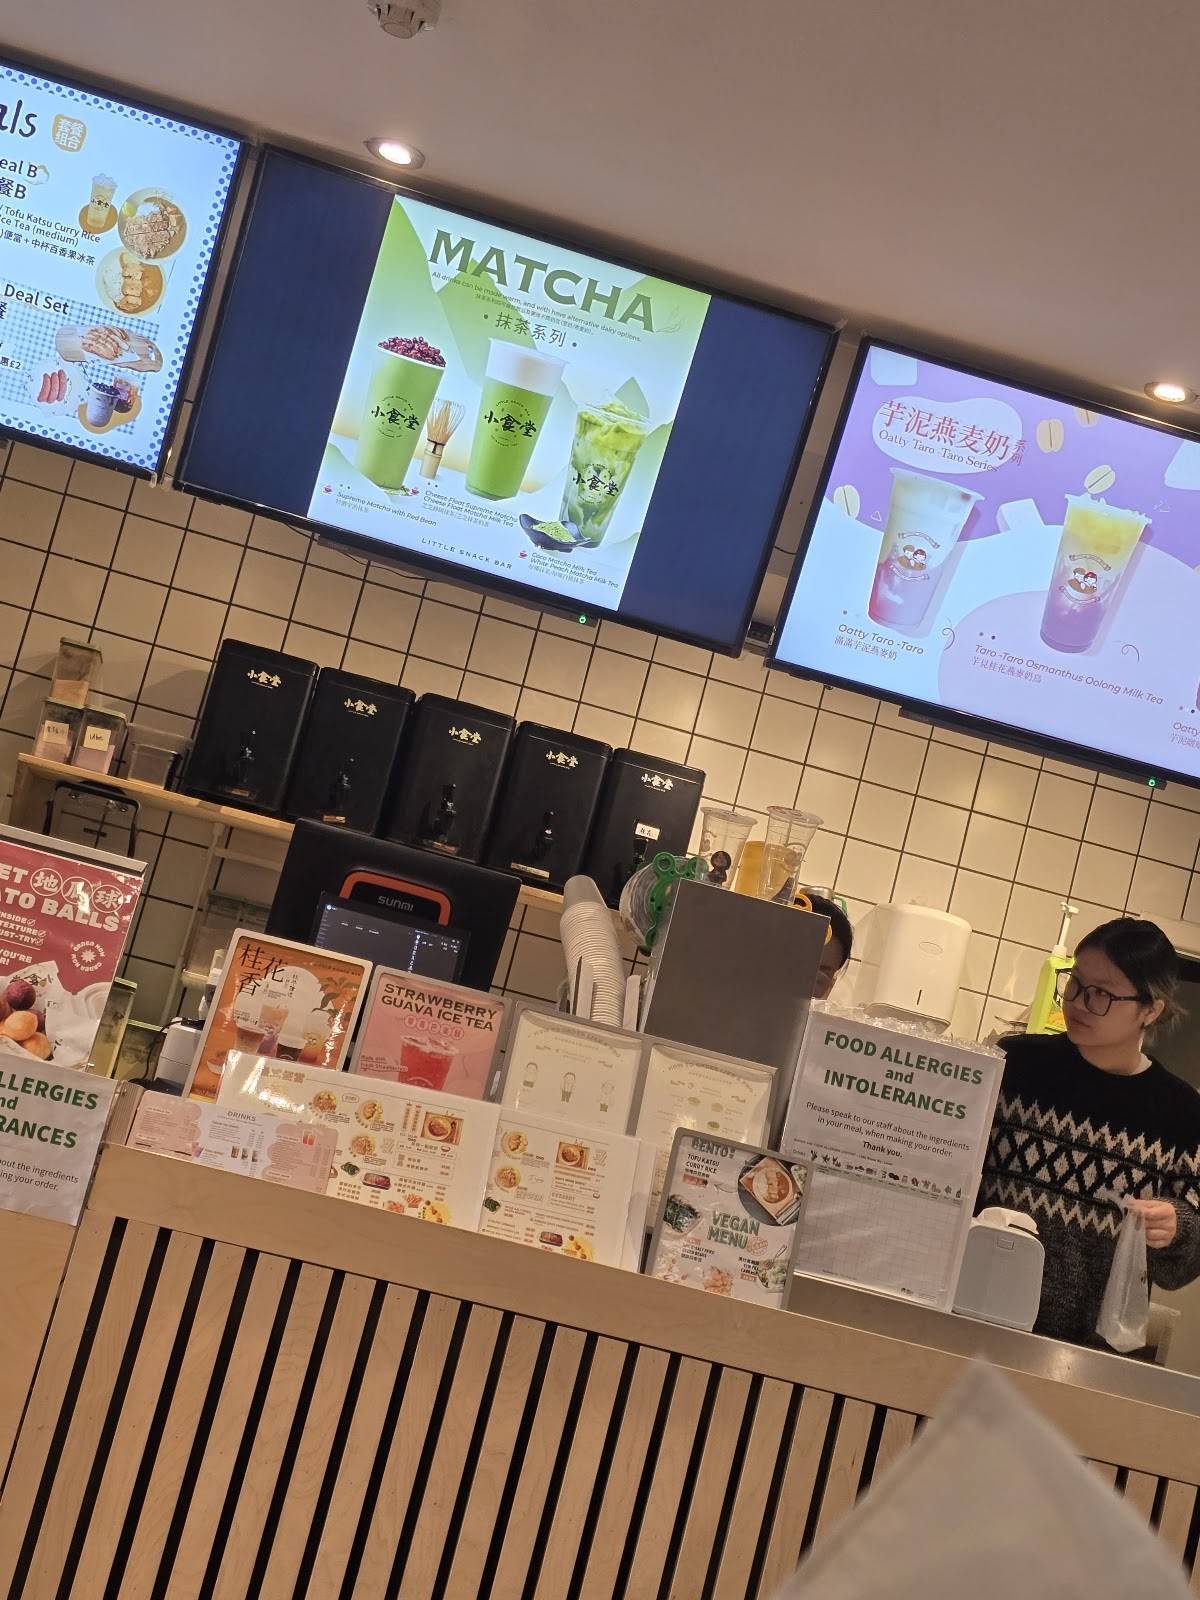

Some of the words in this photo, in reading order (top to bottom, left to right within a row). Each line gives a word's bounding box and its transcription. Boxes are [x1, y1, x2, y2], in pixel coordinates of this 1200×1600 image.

[27, 164, 38, 178] B
[5, 205, 24, 219] Tofu
[26, 212, 53, 228] Katsu
[54, 222, 79, 238] Curry
[81, 230, 101, 243] Rice
[14, 219, 30, 231] Tea
[32, 224, 79, 248] (medium)
[428, 228, 655, 334] MATCHA
[4, 284, 40, 306] Deal
[42, 296, 69, 315] Set
[495, 311, 567, 347] 抹茶系列
[484, 410, 537, 438] 小食堂
[879, 429, 908, 448] Oatty
[912, 438, 935, 455] Taro
[965, 455, 999, 473] Series
[421, 537, 456, 553] LITTLE
[459, 548, 491, 563] SNACK
[494, 558, 514, 570] BAR
[838, 623, 870, 640] Oatty
[871, 632, 895, 647] Taro
[975, 644, 997, 658] Taro
[1026, 658, 1085, 683] Osmanthus
[1085, 675, 1121, 695] Oolong
[1122, 687, 1144, 701] Milk
[1146, 693, 1164, 705] Tea
[0, 911, 27, 925] NSIDE
[0, 920, 38, 936] TEXTURE
[41, 897, 119, 932] BALLS
[240, 943, 289, 983] 桂花
[239, 972, 262, 996] 香
[382, 995, 433, 1017] GUAVA
[437, 1008, 461, 1025] ICE
[465, 1016, 494, 1032] TEA
[384, 983, 497, 1020] STRAWBERRY
[824, 1030, 877, 1057] FOOD
[880, 1046, 984, 1085] ALLERGIES
[0, 1071, 99, 1110] LLERGIES
[885, 1068, 915, 1085] and
[0, 1096, 18, 1111] nd
[823, 1069, 967, 1120] INTOLERANCES
[227, 1110, 257, 1122] DRINKS
[806, 1101, 830, 1114] Please
[831, 1108, 853, 1122] speak
[854, 1114, 861, 1122] to
[862, 1117, 875, 1127] our
[876, 1119, 893, 1130] staff
[893, 1125, 915, 1137] about
[916, 1130, 928, 1140] the
[929, 1134, 971, 1151] ingredients
[817, 1115, 825, 1125] in
[824, 1119, 843, 1132] your
[843, 1122, 864, 1136] meal,
[865, 1129, 886, 1141] when
[886, 1134, 914, 1148] making
[914, 1142, 932, 1153] your
[931, 1146, 953, 1158] order.
[862, 1140, 886, 1153] Thank
[887, 1147, 903, 1158] you.
[17, 1163, 31, 1173] the
[32, 1167, 79, 1184] ingredients
[686, 1161, 705, 1171] CURRY
[688, 1153, 702, 1163] TOFU
[702, 1158, 720, 1167] KATSU
[14, 1175, 34, 1186] your
[35, 1180, 59, 1192] order.
[707, 1226, 749, 1250] MENU
[712, 1211, 760, 1237] VEGAN
